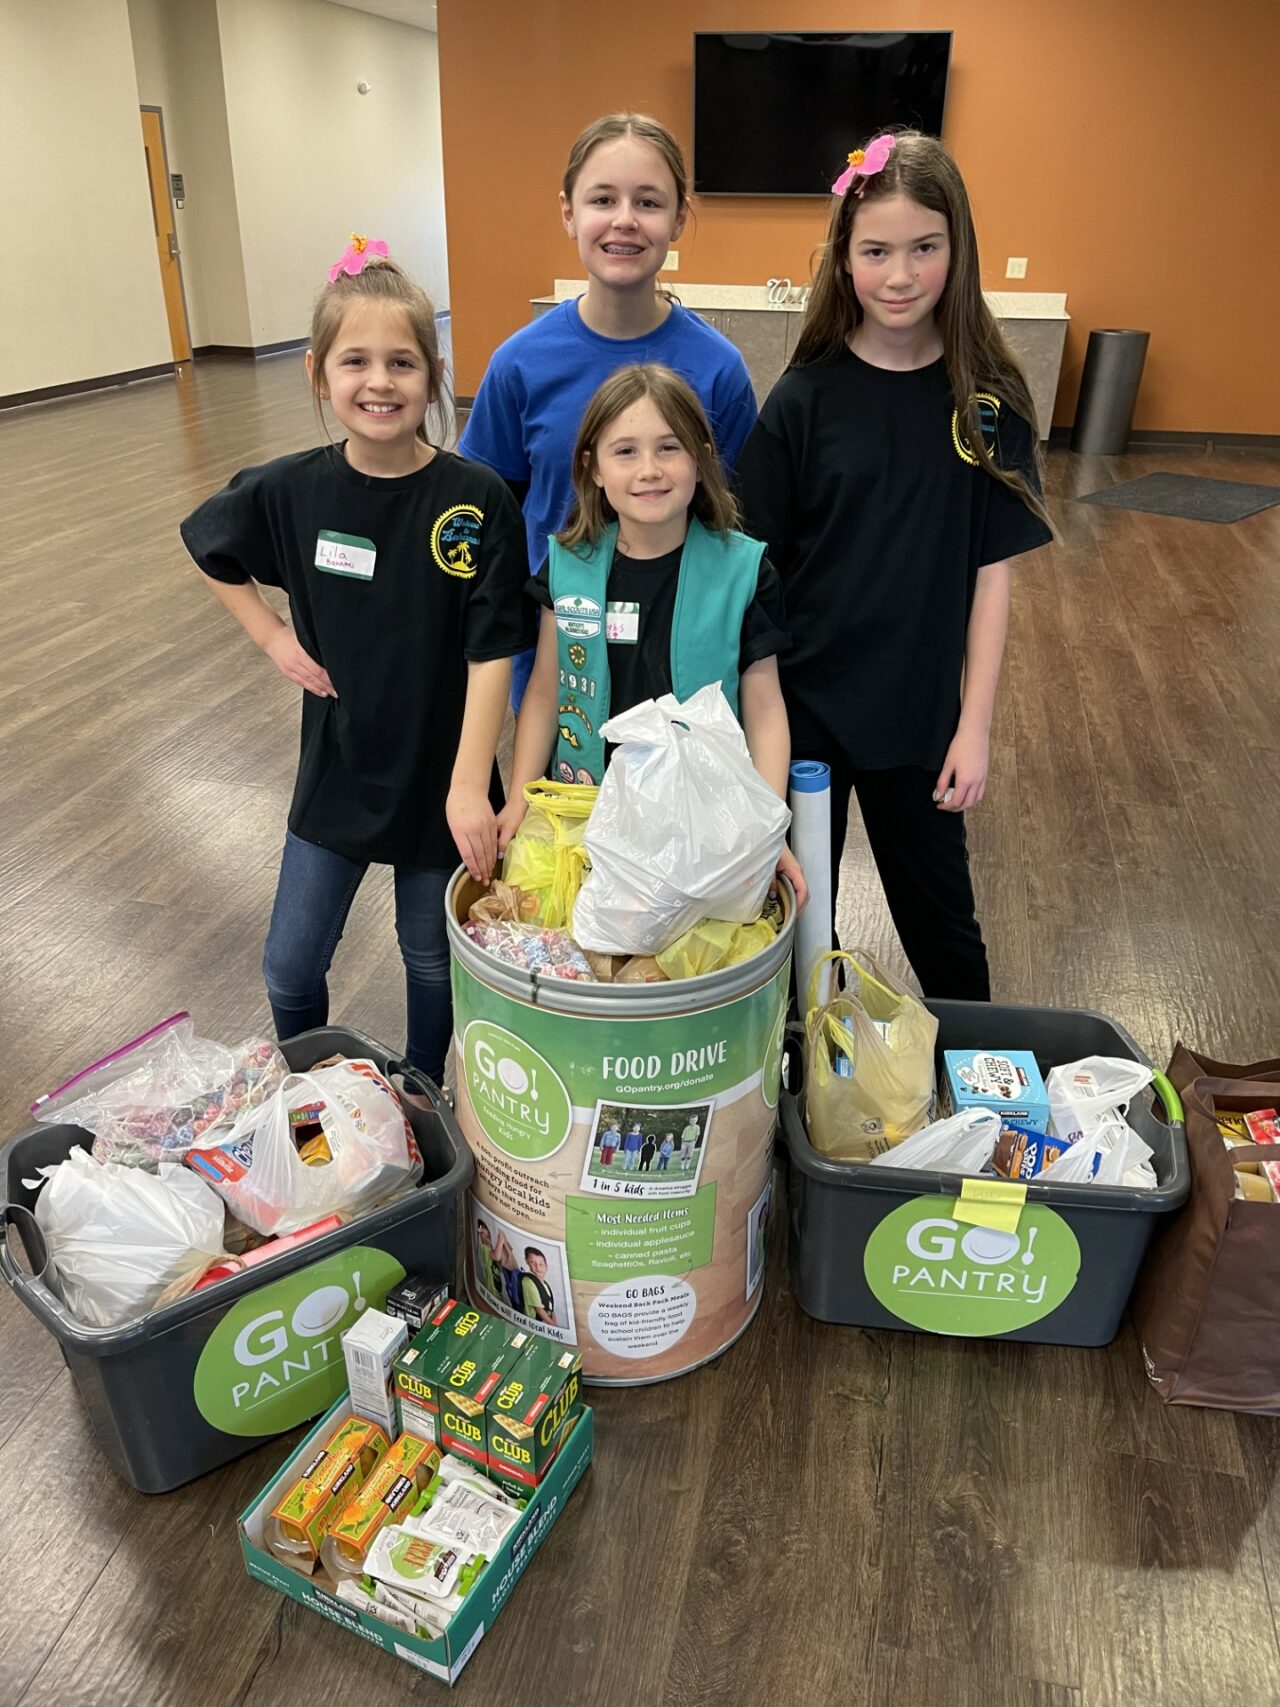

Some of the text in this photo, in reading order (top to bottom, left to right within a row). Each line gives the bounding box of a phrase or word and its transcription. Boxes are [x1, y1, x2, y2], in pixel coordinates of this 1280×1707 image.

[320, 547, 347, 559] Lila
[602, 1040, 728, 1080] FOOD DRIVE
[984, 1057, 1001, 1084] CHEWY
[997, 1060, 1012, 1077] SOFT
[615, 1073, 714, 1094] GOpantry.org/donate
[472, 1071, 549, 1135] PANTRY
[511, 1176, 528, 1190] food
[529, 1185, 543, 1195] for
[513, 1168, 549, 1188] outreach
[593, 1178, 645, 1196] 1 in 5 kids
[501, 1190, 516, 1204] that
[517, 1200, 546, 1217] schools
[504, 1180, 526, 1199] local
[528, 1193, 551, 1209] kids
[597, 1207, 689, 1225] Most Needed Items
[600, 1227, 647, 1236] individual
[649, 1225, 668, 1234] fruit
[669, 1220, 692, 1232] cups
[595, 1240, 641, 1249] individual
[643, 1230, 695, 1247] applesauce
[906, 1218, 1038, 1266] GO!
[614, 1251, 650, 1259] canned
[652, 1247, 678, 1257] pasta
[626, 1285, 665, 1299] GO BAGS
[892, 1265, 1047, 1304] PANTRY
[233, 1271, 366, 1367] GO!
[455, 1311, 480, 1337] CLUB
[634, 1309, 660, 1318] provide
[528, 1321, 546, 1333] local
[635, 1324, 662, 1333] children
[628, 1341, 658, 1349] weekend
[231, 1334, 341, 1408] PANT
[450, 1360, 476, 1386] CLUB
[398, 1373, 432, 1398] CLUB
[497, 1381, 524, 1409] CLUB
[541, 1375, 579, 1447] CLUB
[444, 1413, 482, 1441] CLUB
[492, 1436, 531, 1464] CLUB
[303, 1451, 325, 1477] KIRKLAND
[332, 1463, 354, 1492] KIRKLAND
[391, 1481, 411, 1509] KIRKLAND
[512, 1508, 540, 1550] KIRKLAND
[492, 1495, 558, 1603] HOUSE BLEND
[316, 1589, 357, 1618] KIRKLAND
[302, 1592, 342, 1624] HOUSE
[344, 1617, 384, 1642] BLEND
